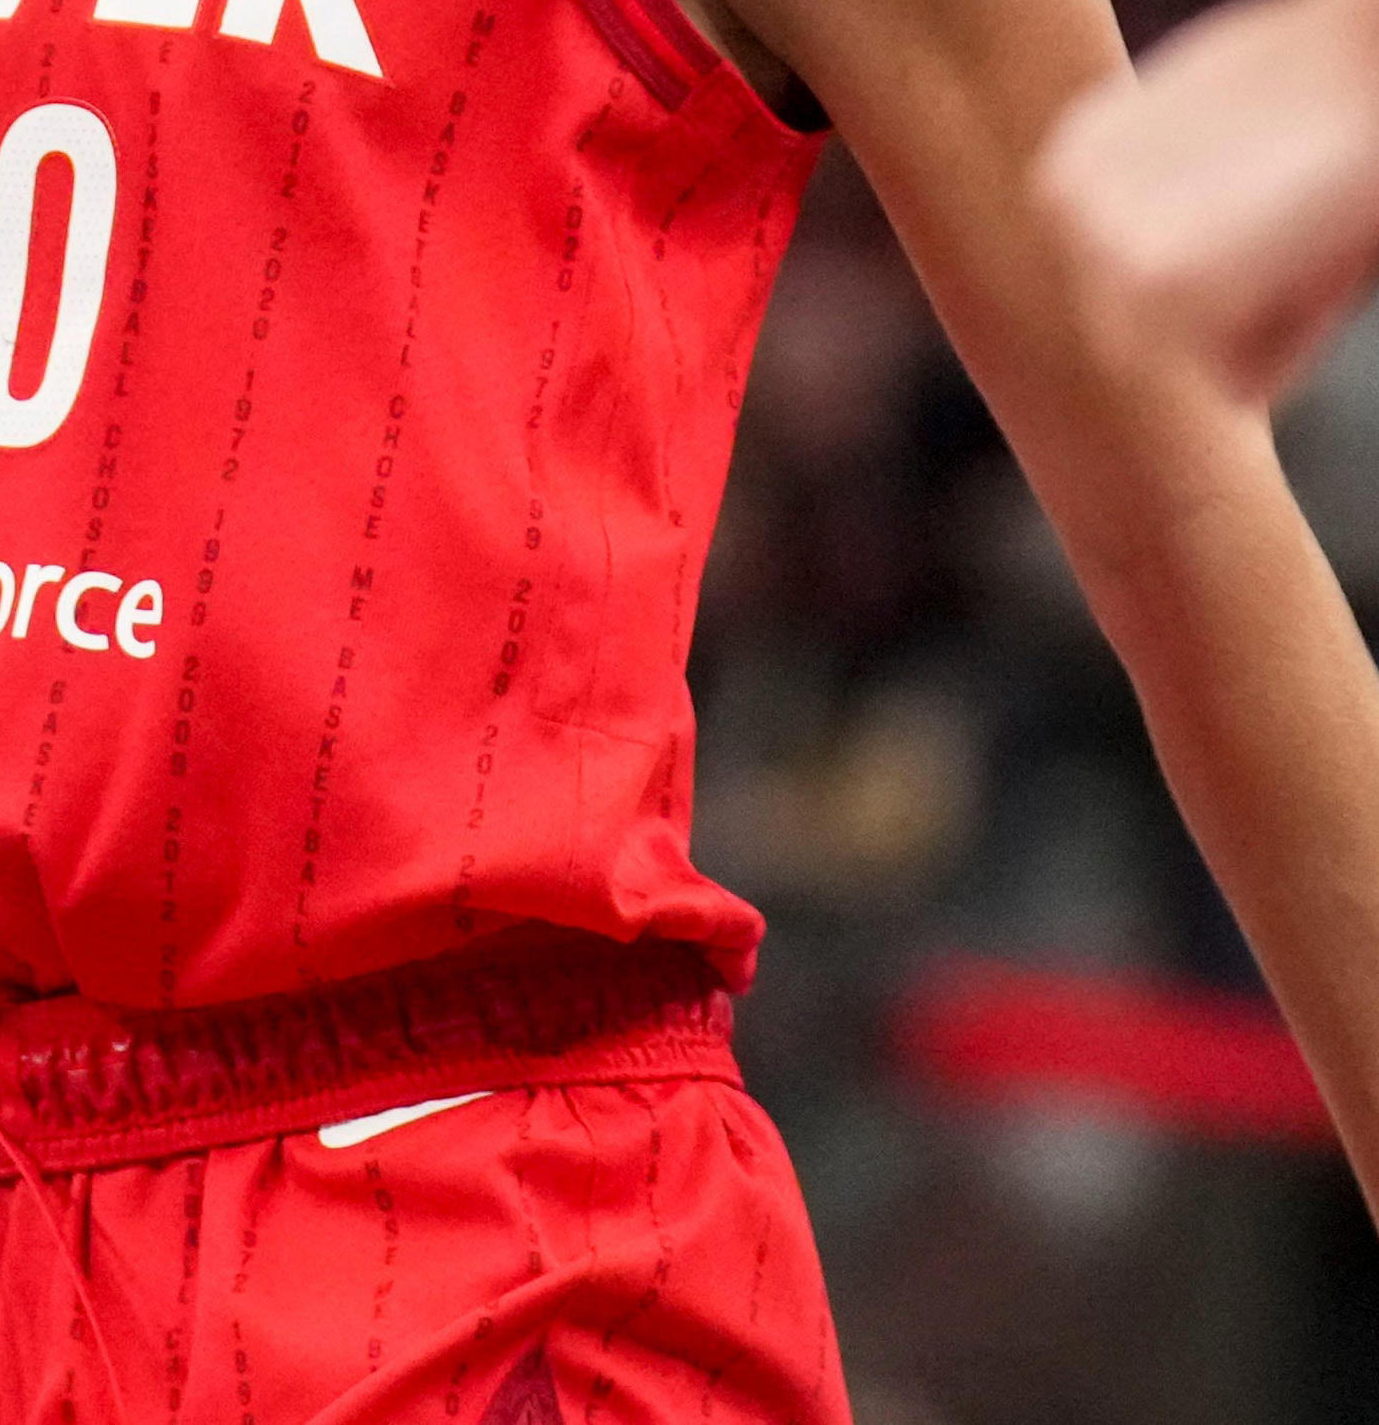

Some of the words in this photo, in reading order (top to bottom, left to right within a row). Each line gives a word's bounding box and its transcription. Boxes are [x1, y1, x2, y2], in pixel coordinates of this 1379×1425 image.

[281, 80, 316, 199] 2012
[253, 226, 288, 340] 2020
[222, 369, 255, 481] 1972
[526, 320, 560, 429] 1972
[364, 395, 407, 540] CHOSE
[191, 509, 224, 627] 1999
[349, 565, 375, 621] ME
[492, 578, 532, 696] 2009
[170, 656, 200, 777] 2009
[294, 646, 355, 950] BASKETBALL
[468, 724, 498, 829] 2012
